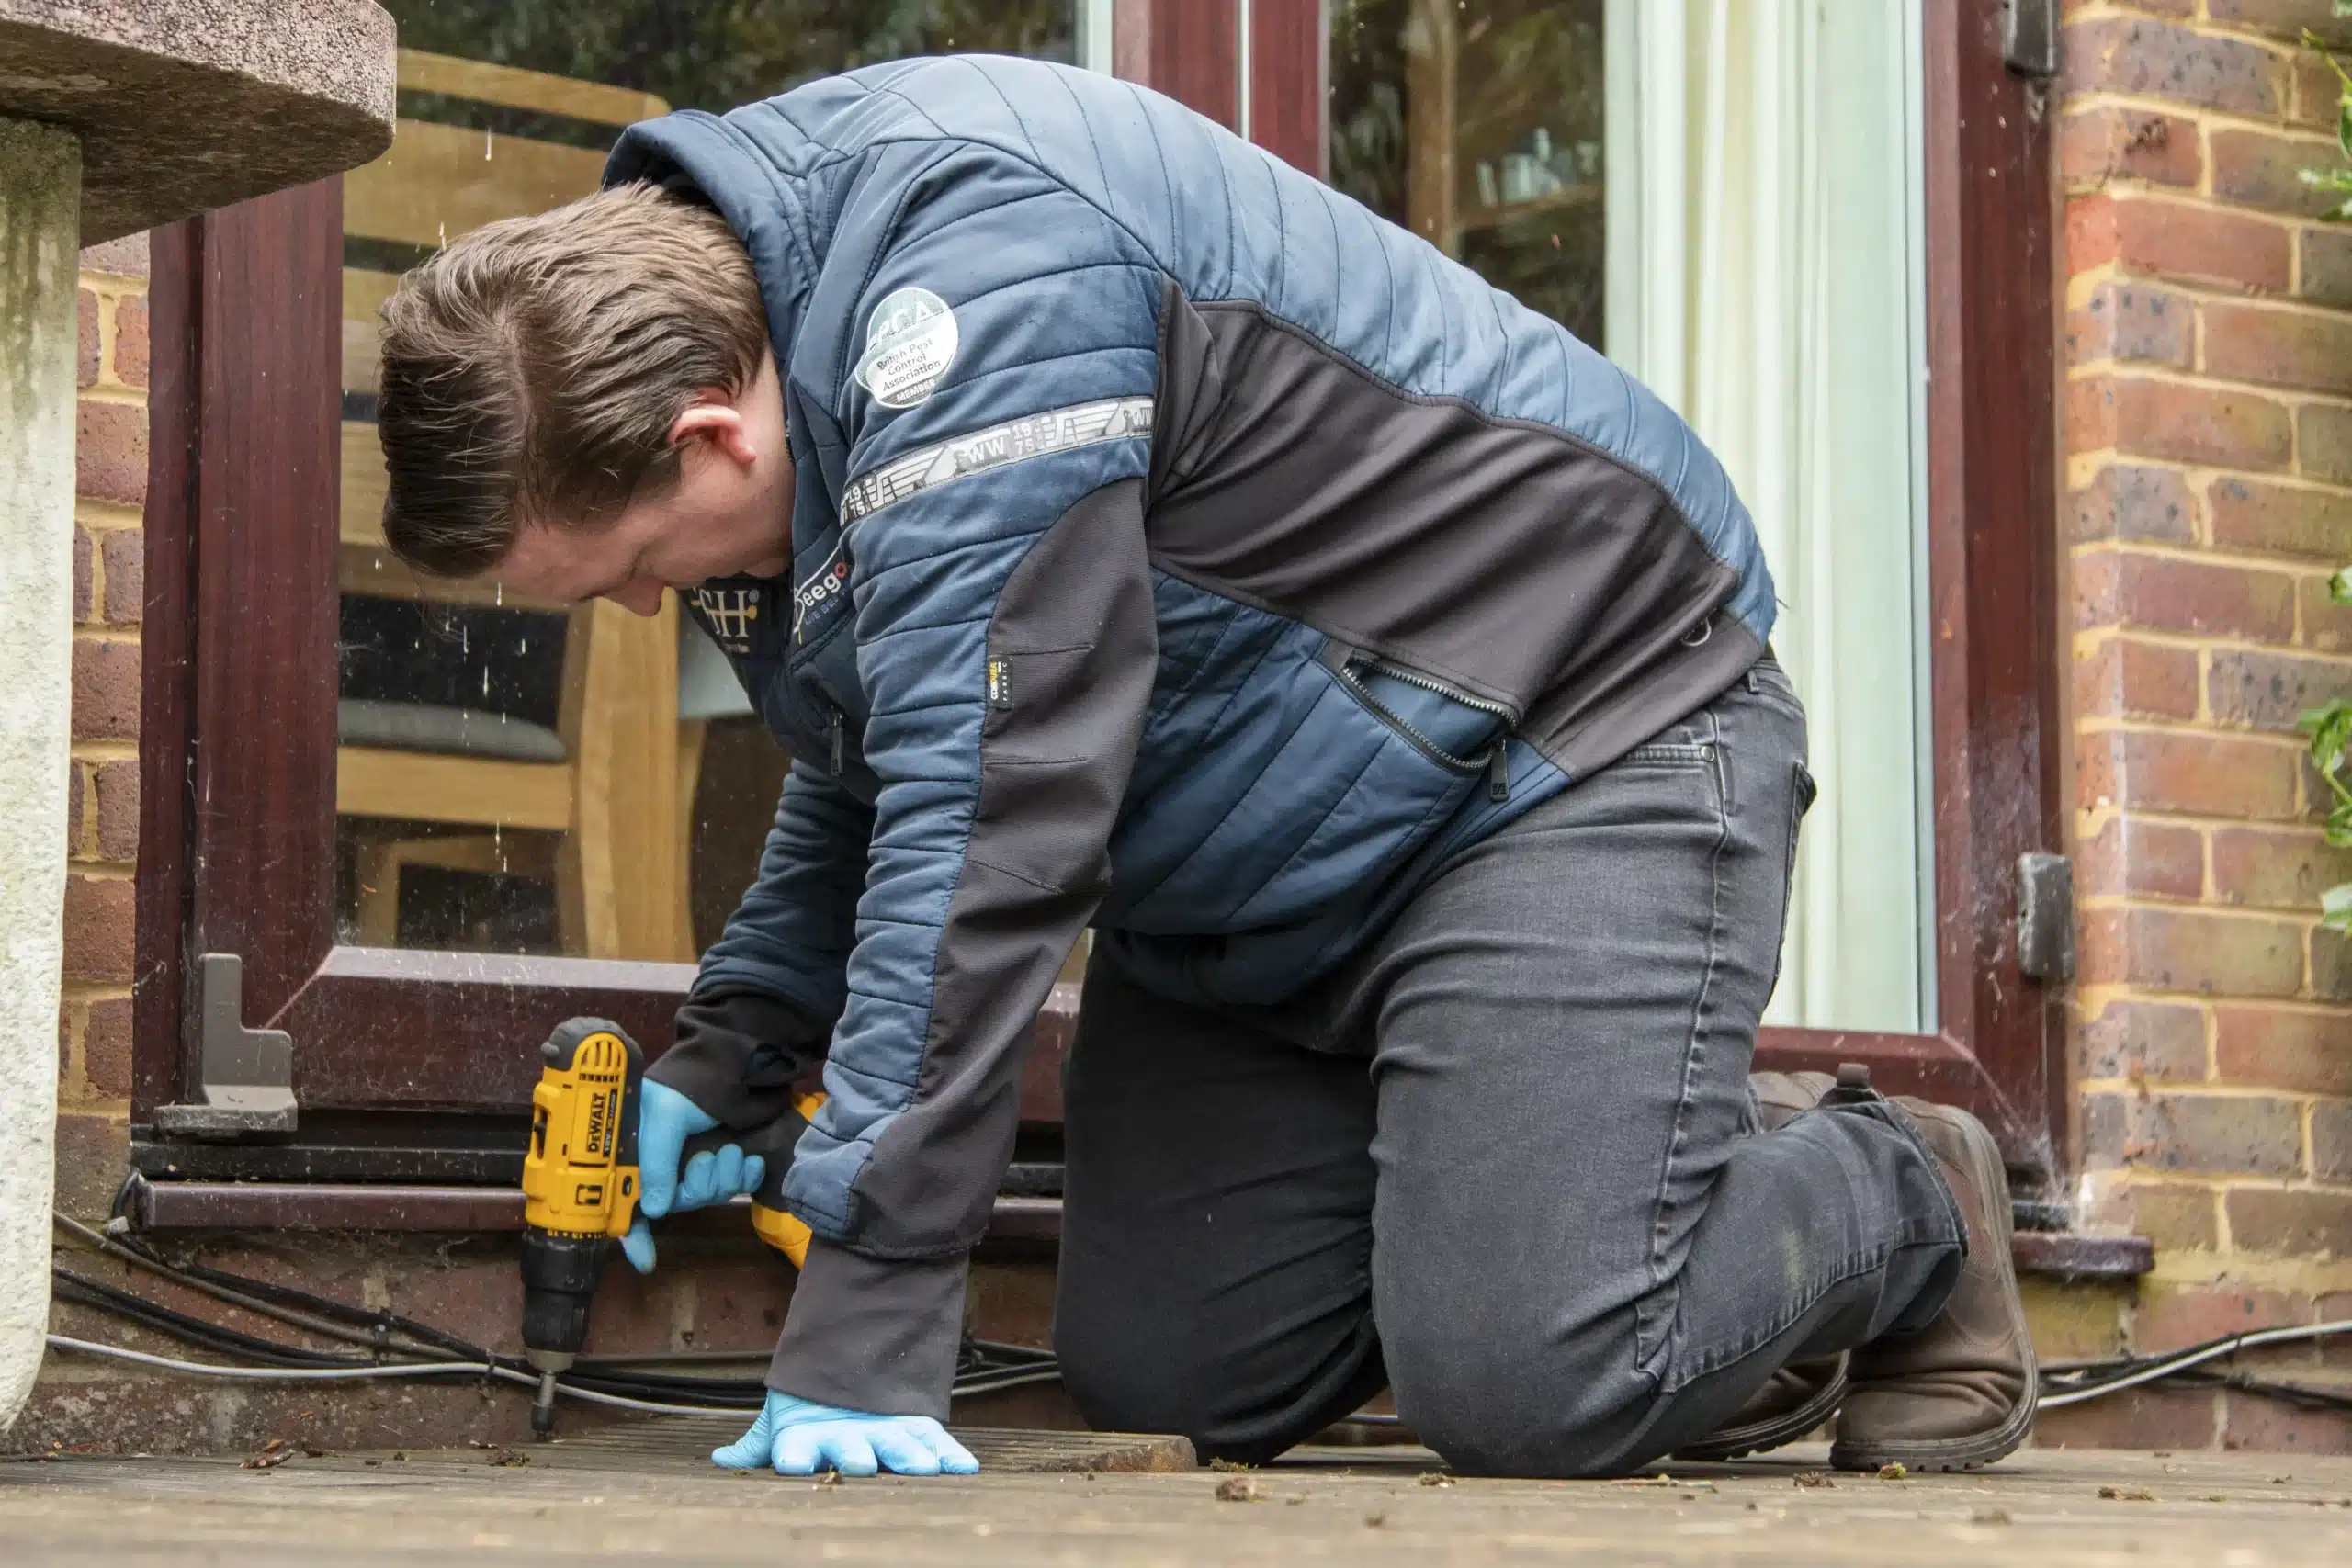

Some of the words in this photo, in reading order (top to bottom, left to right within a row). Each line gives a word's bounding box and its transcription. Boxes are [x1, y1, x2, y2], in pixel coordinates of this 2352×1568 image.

[876, 348, 907, 371] British
[909, 337, 934, 354] Pest
[888, 350, 927, 376] Control
[882, 359, 942, 392] Association
[849, 485, 862, 502] 19
